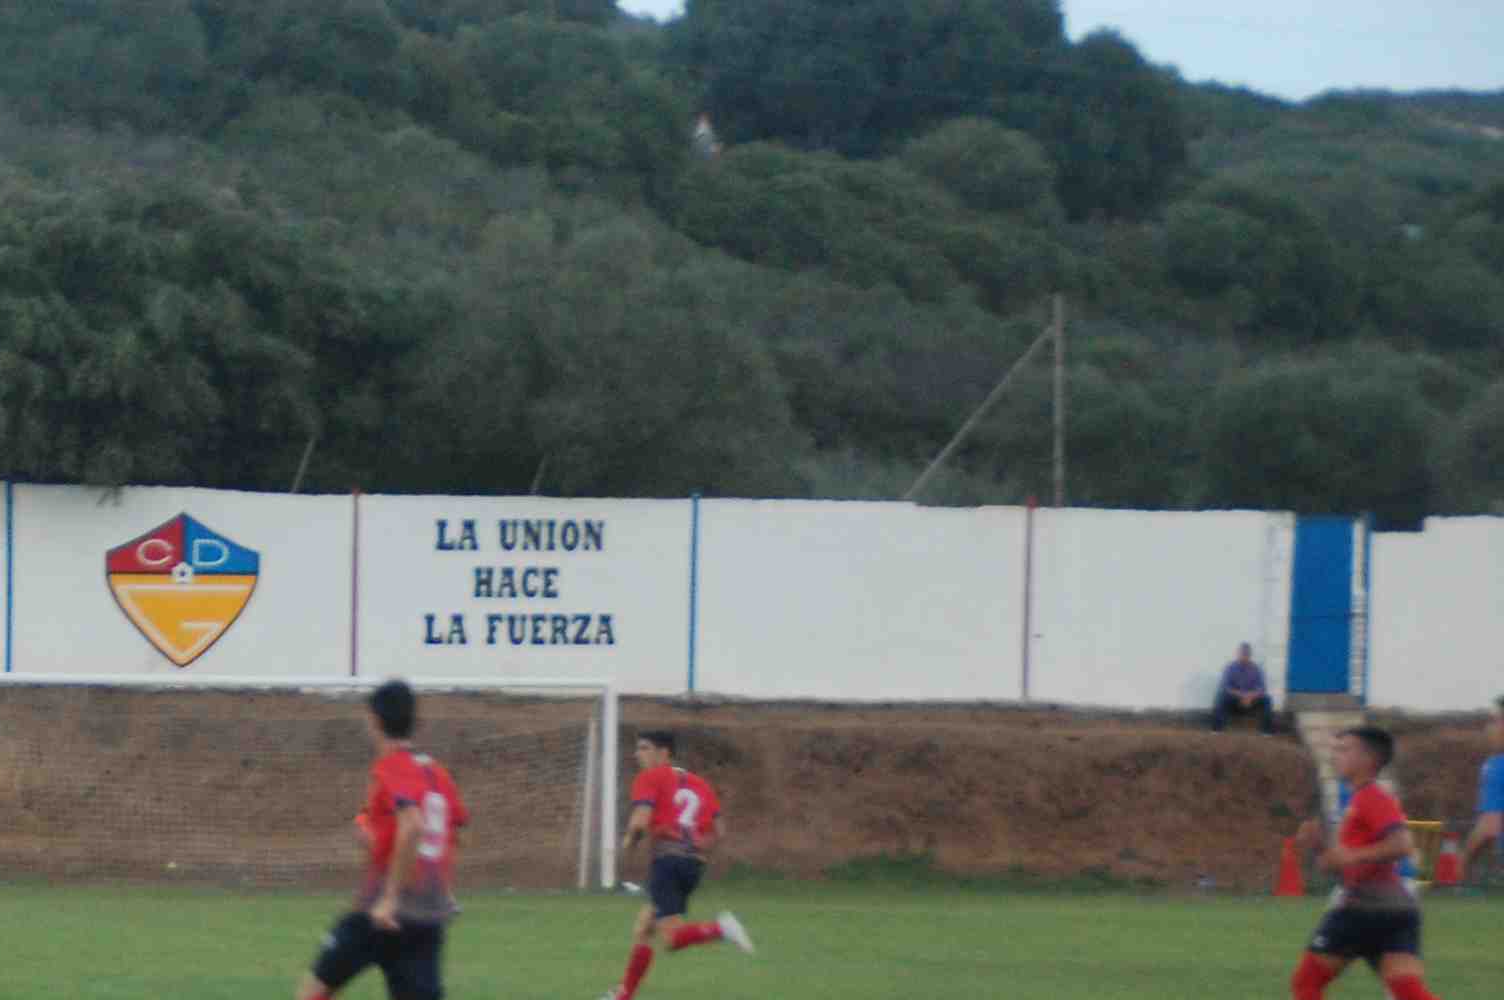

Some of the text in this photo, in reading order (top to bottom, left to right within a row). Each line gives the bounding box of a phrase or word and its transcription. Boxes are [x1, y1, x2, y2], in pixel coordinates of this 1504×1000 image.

[435, 519, 605, 552] LA UNION
[473, 566, 559, 599] HACE
[423, 613, 615, 645] LA FUERZA
